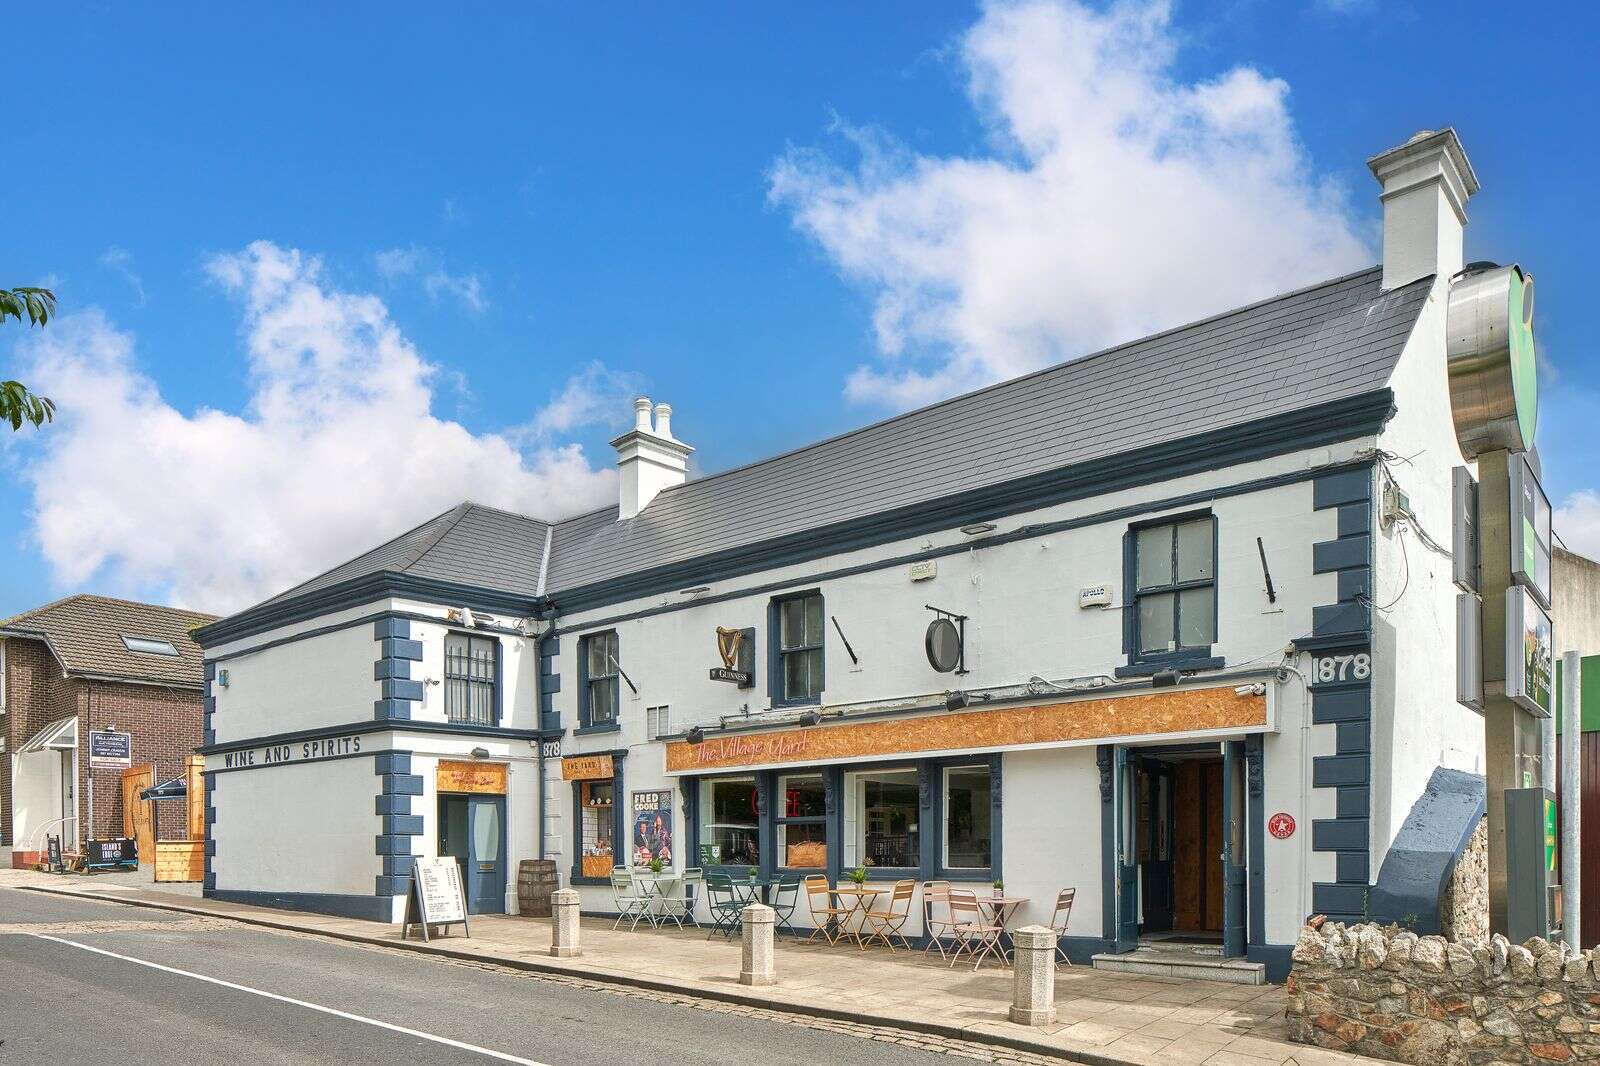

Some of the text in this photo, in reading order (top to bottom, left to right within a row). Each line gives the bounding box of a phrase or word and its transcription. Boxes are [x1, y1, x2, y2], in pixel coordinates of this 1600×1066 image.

[719, 669, 749, 681] GUINNESS
[1312, 653, 1371, 683] 1878
[224, 736, 361, 768] WINE AND SPIRITS
[695, 730, 808, 765] The Village Yard
[634, 792, 659, 803] FRED
[634, 803, 659, 811] COOKE
